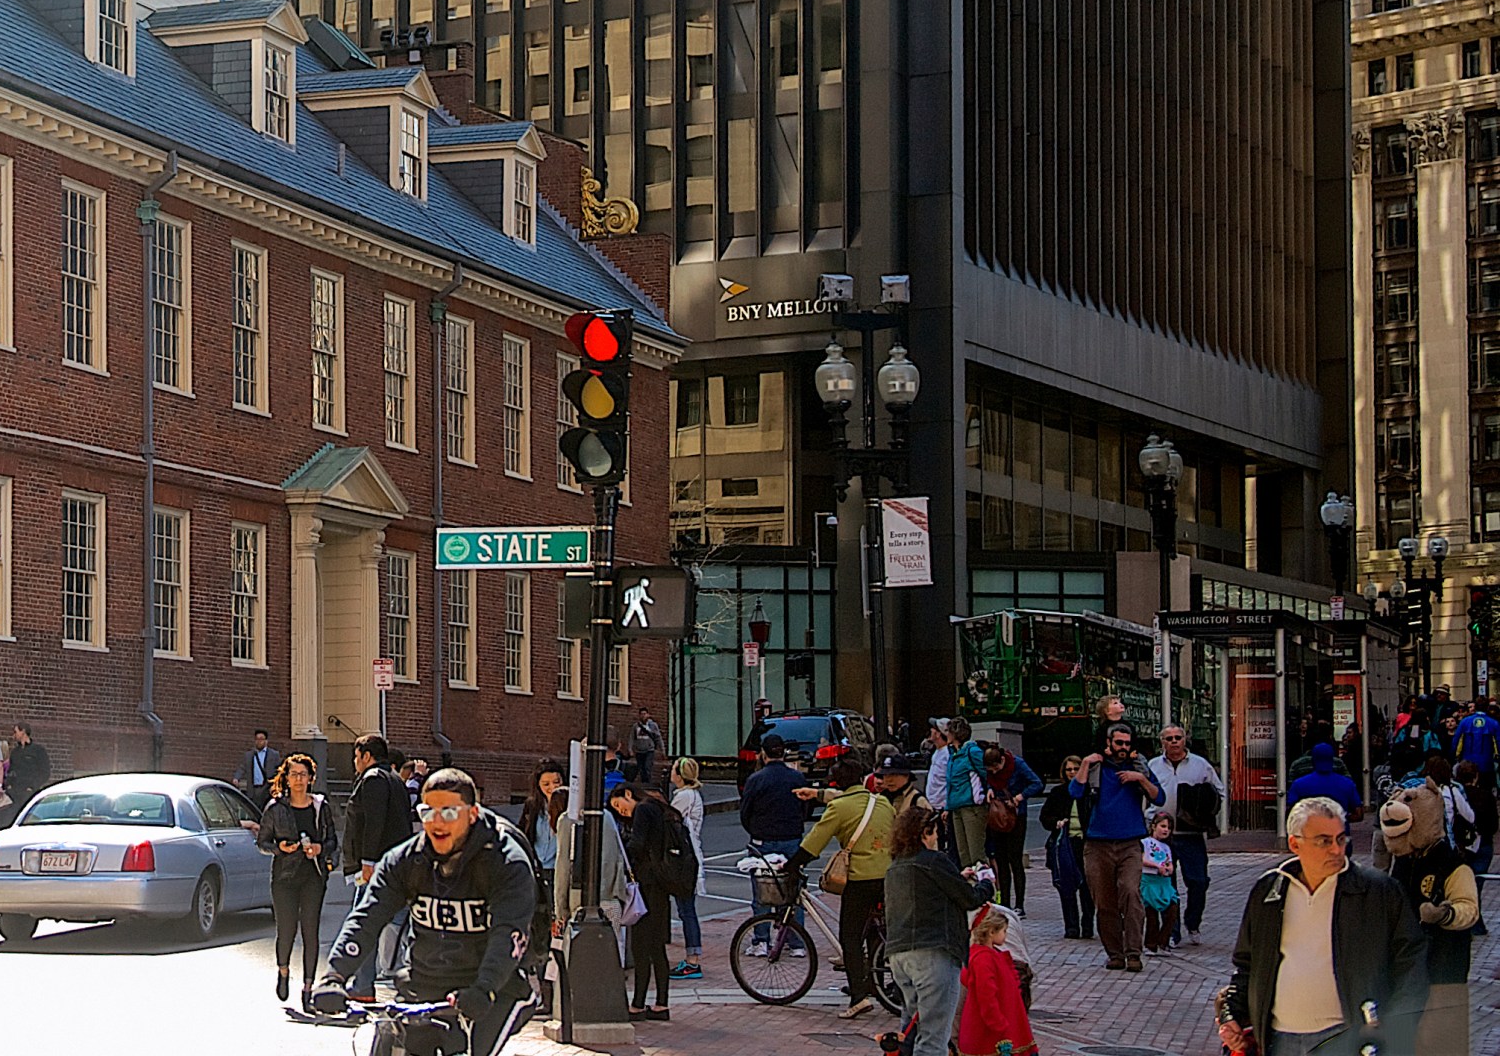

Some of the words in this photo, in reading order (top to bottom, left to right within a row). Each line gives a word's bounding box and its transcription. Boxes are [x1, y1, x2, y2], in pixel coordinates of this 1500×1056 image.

[727, 304, 762, 322] BNY
[890, 531, 907, 540] Every
[476, 534, 552, 562] STATE
[566, 546, 582, 561] ST
[1167, 615, 1230, 626] WASHINGTON
[1236, 615, 1273, 625] STREET
